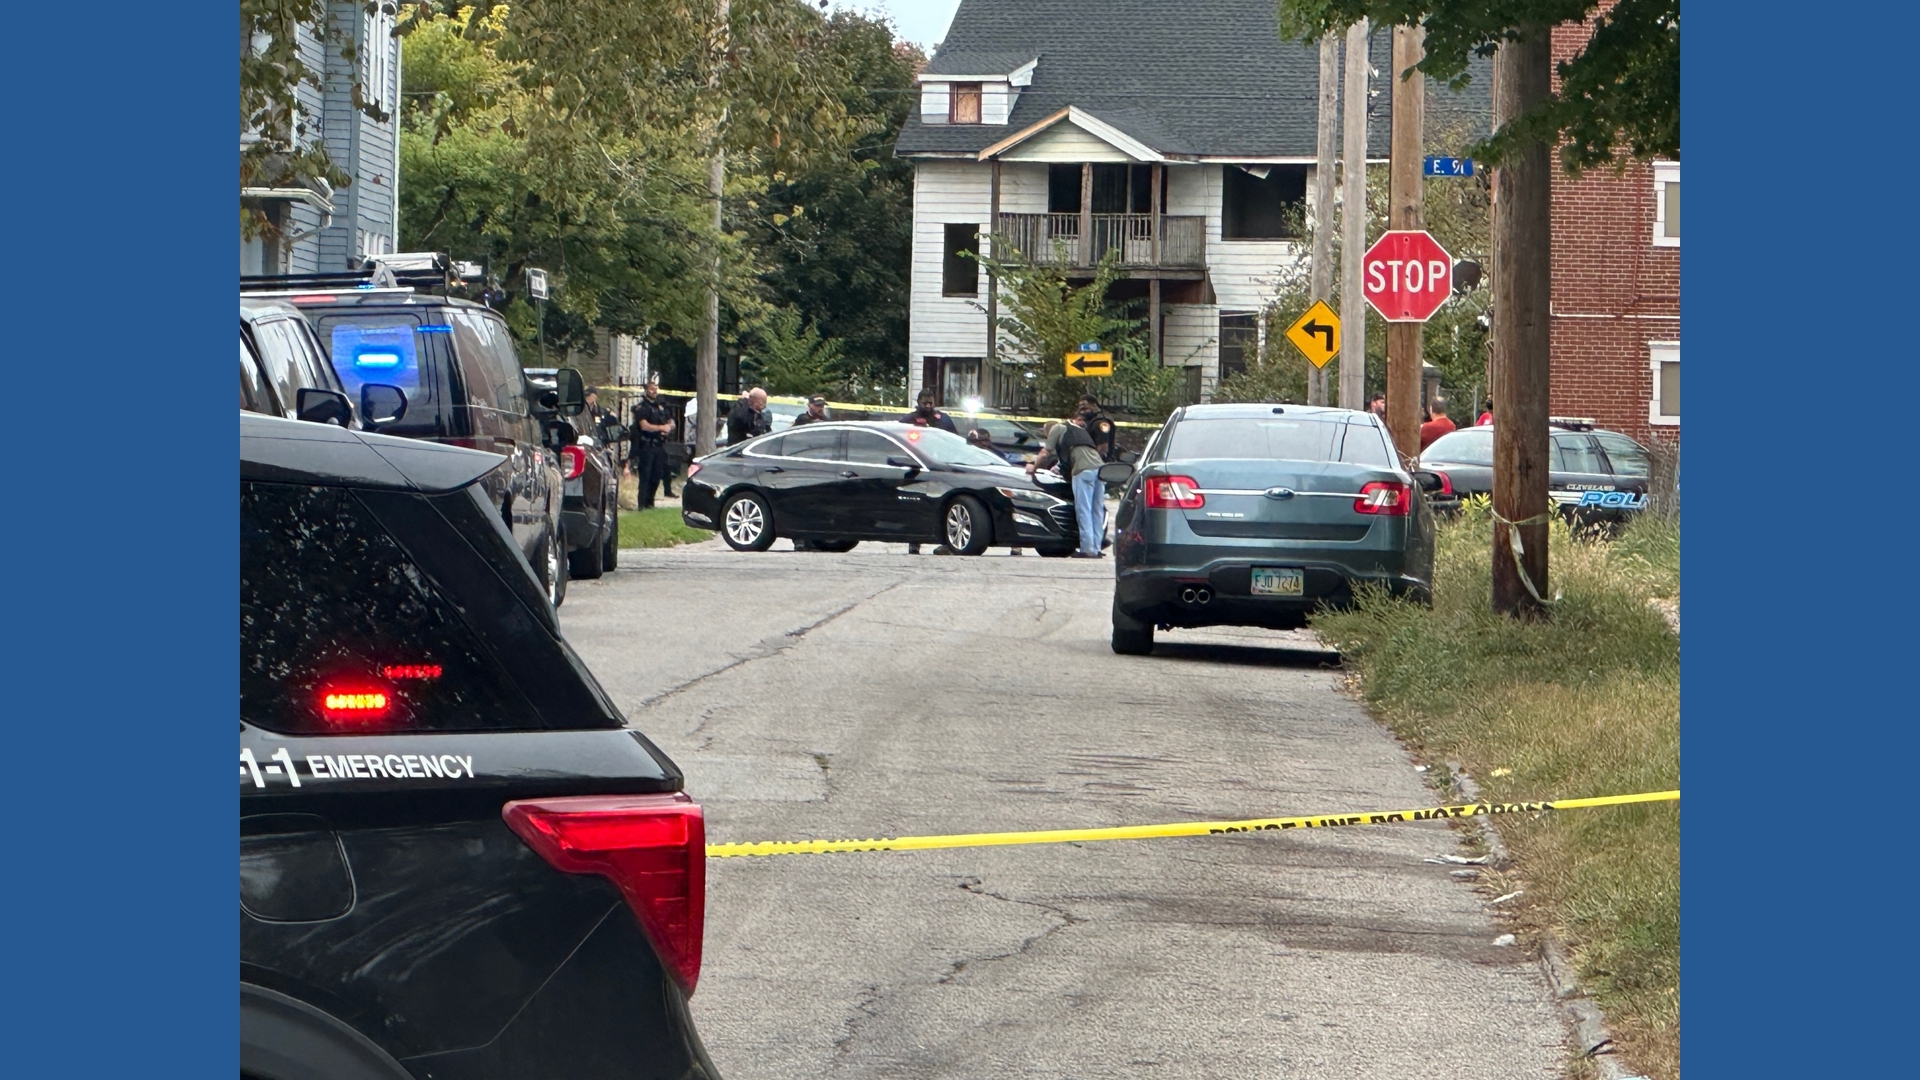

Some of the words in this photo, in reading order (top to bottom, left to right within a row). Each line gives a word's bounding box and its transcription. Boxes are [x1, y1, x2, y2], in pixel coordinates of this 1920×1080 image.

[1433, 159, 1445, 174] E.
[1367, 259, 1446, 293] STOP
[306, 754, 474, 778] EMERGENCY
